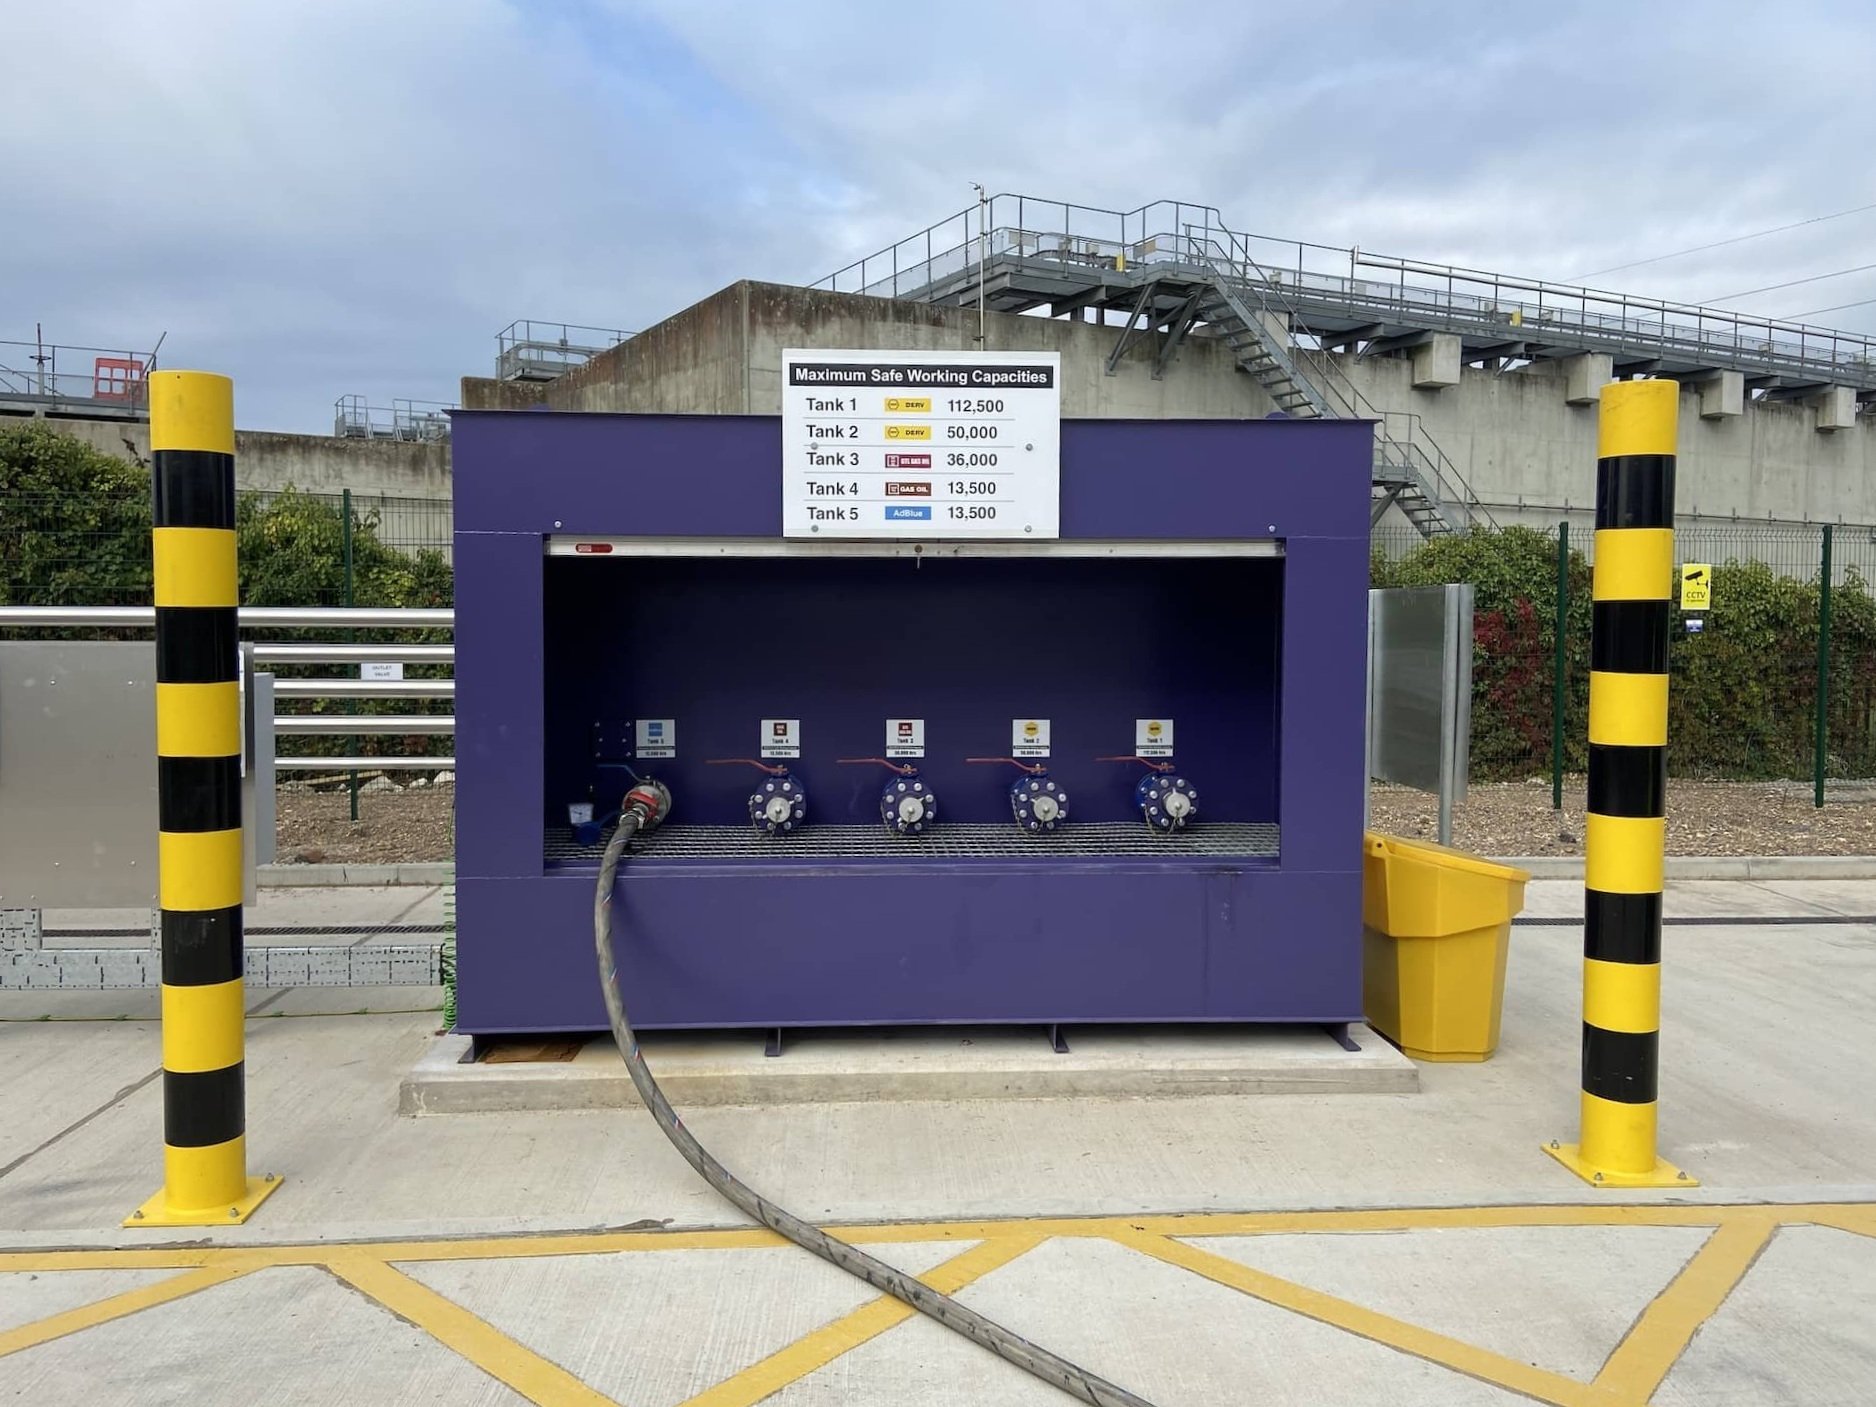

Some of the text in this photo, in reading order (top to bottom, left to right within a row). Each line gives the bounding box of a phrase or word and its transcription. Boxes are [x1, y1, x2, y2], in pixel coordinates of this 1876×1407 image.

[795, 367, 1048, 386] Maximum Safe Working Capacities
[805, 397, 844, 411] Tank
[850, 397, 856, 411] 1
[947, 399, 1004, 414] 112,500
[805, 424, 844, 438] Tank
[849, 425, 858, 438] 2
[947, 426, 998, 440] 50,000
[806, 452, 845, 466] Tank
[850, 452, 859, 466] 3
[947, 453, 998, 468] 36,000
[806, 481, 845, 495] Tank
[849, 482, 858, 495] 4
[947, 481, 996, 496] 13,500
[806, 506, 996, 521] Tank 5 AdBlue 13,500
[1686, 591, 1706, 599] CCTV
